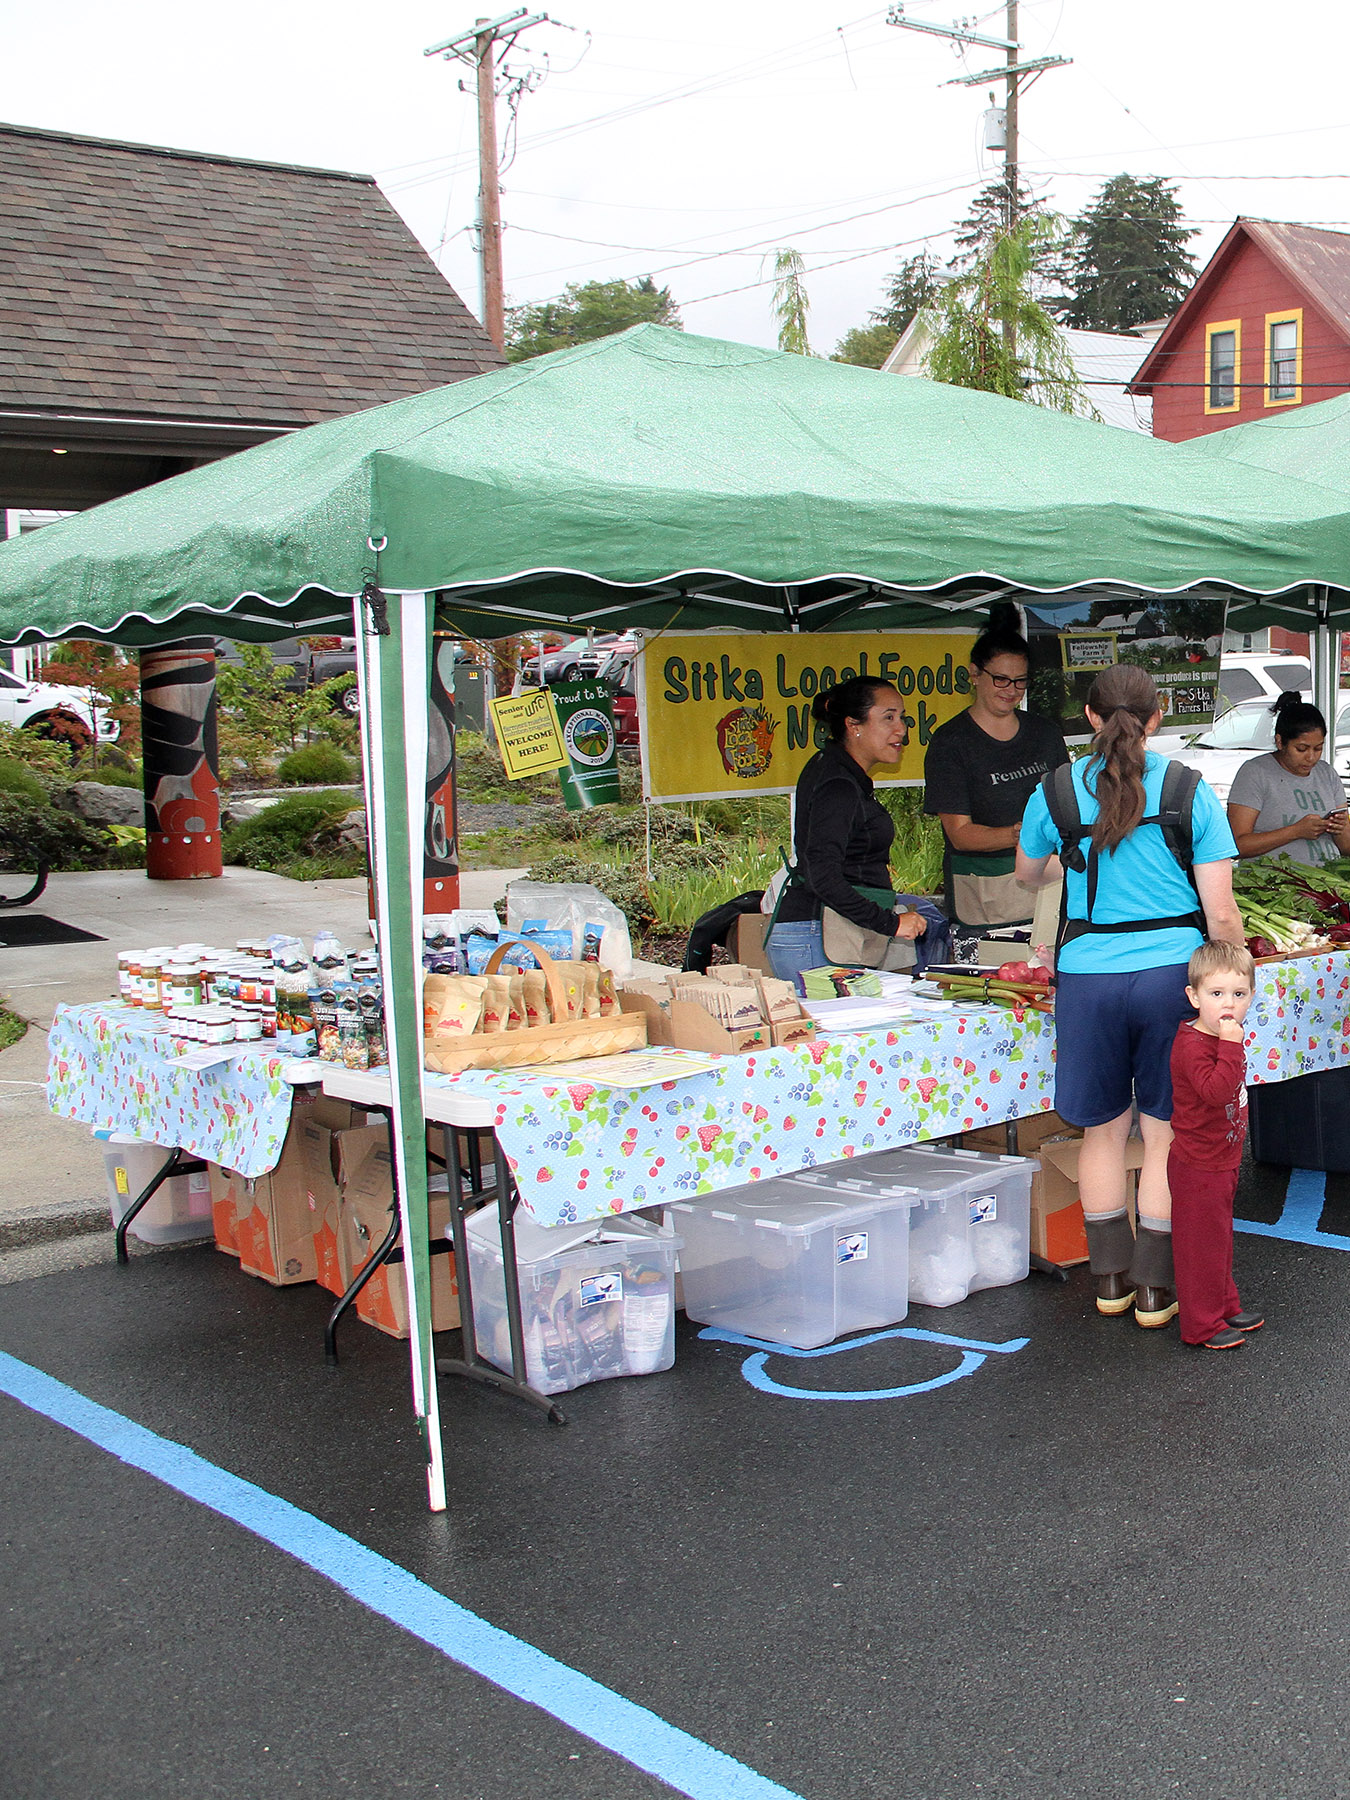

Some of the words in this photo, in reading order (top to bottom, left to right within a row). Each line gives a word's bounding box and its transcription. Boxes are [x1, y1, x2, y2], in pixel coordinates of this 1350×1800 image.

[664, 654, 763, 703] Sitka
[879, 652, 970, 696] Foods
[1165, 672, 1192, 683] produce
[1193, 671, 1200, 681] is
[552, 691, 581, 706] Proud
[584, 690, 595, 700] to
[597, 686, 610, 698] Be
[498, 705, 525, 716] Senior
[787, 700, 937, 750] Nerk
[506, 729, 554, 747] WELCOME
[518, 743, 549, 757] HERE!
[1293, 788, 1327, 812] OH
